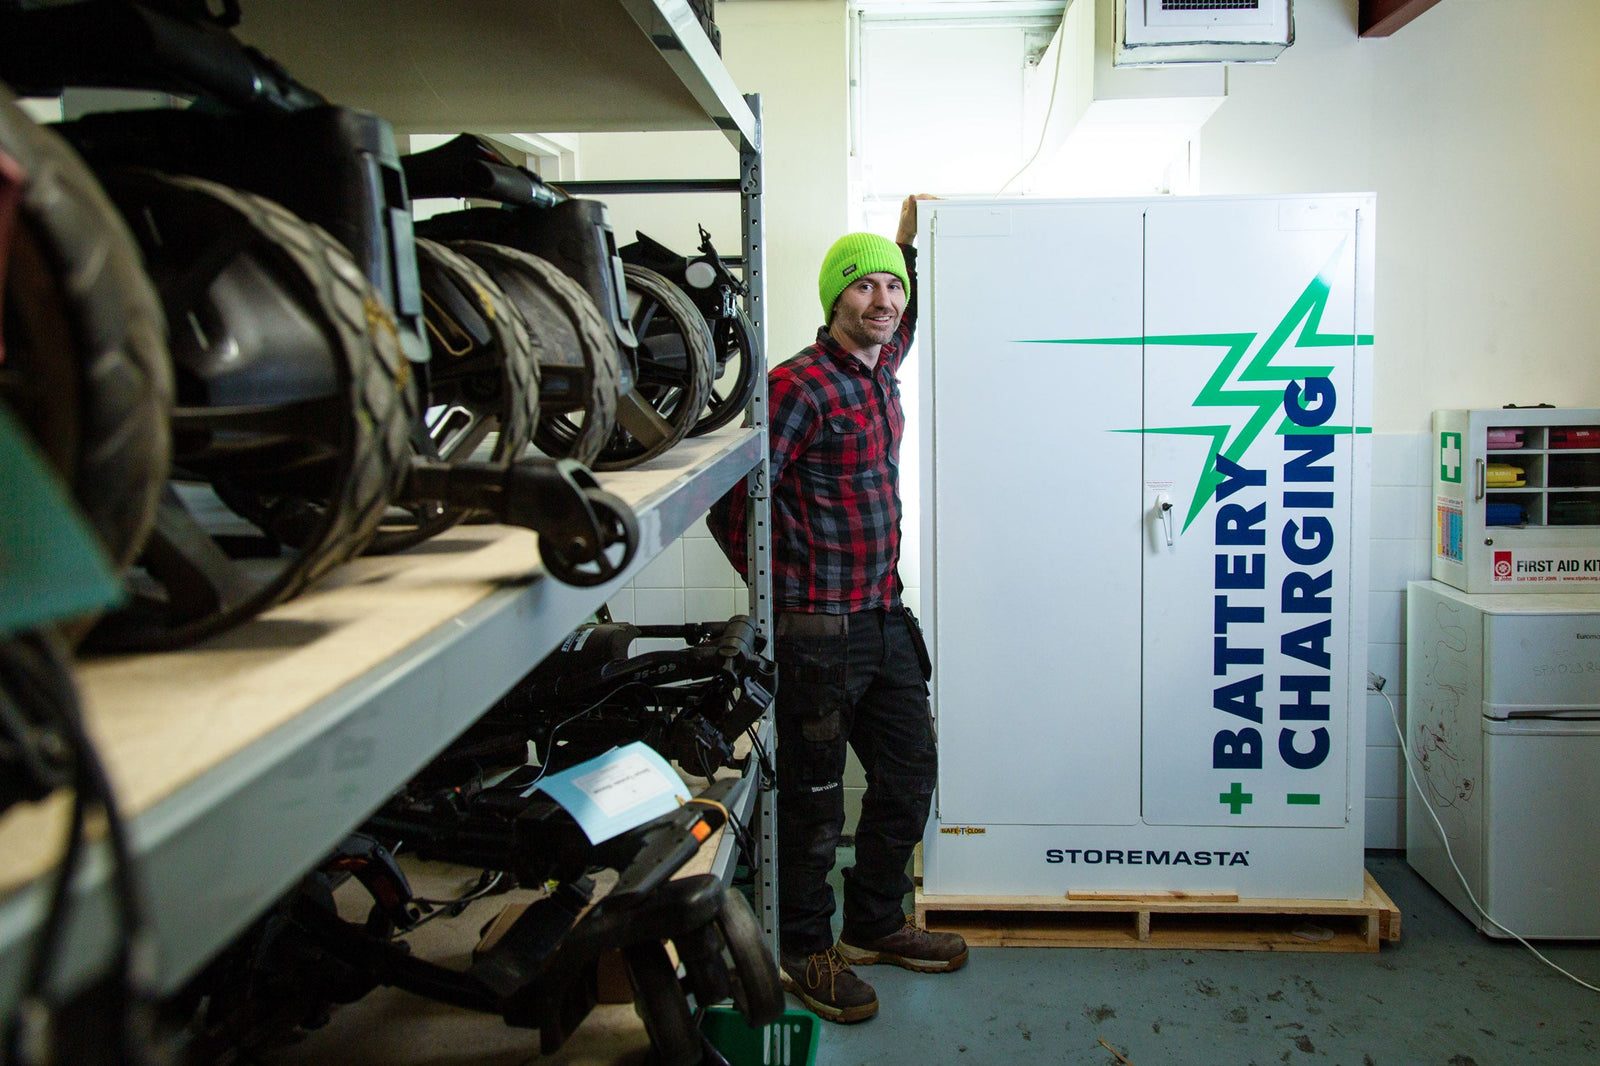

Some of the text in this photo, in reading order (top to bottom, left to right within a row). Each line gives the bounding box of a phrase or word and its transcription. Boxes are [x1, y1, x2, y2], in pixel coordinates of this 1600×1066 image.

[1213, 453, 1267, 769] BATTERY
[1278, 377, 1336, 770] CHARGING
[1517, 559, 1554, 573] FIRST
[1557, 559, 1580, 572] AID
[1046, 849, 1250, 867] STOREMASTA
